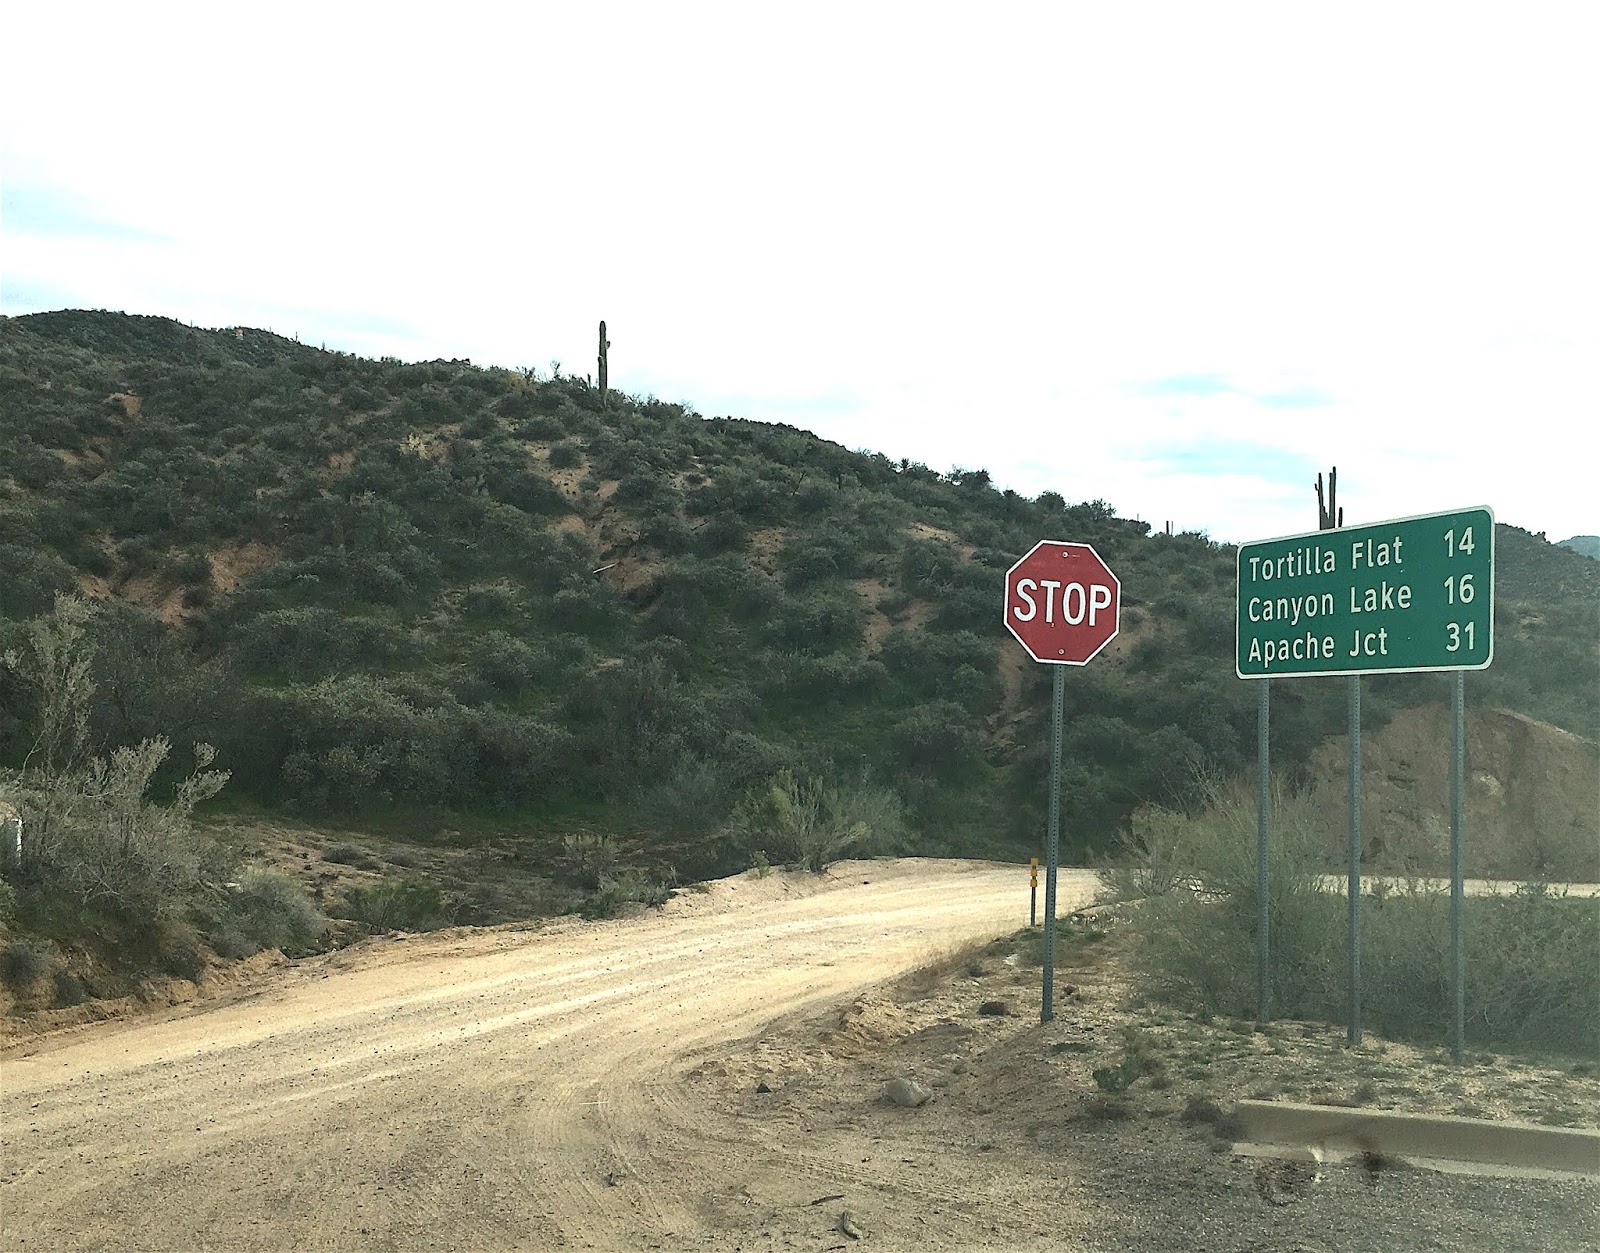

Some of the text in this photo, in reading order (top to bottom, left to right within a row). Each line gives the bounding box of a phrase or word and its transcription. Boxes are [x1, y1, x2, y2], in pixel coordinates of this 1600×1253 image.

[1249, 526, 1475, 582] Tortilla Flat 14
[1013, 578, 1112, 627] STOP
[1248, 573, 1476, 626] Canyon Lake 16
[1248, 621, 1475, 668] Apache Jct 31
